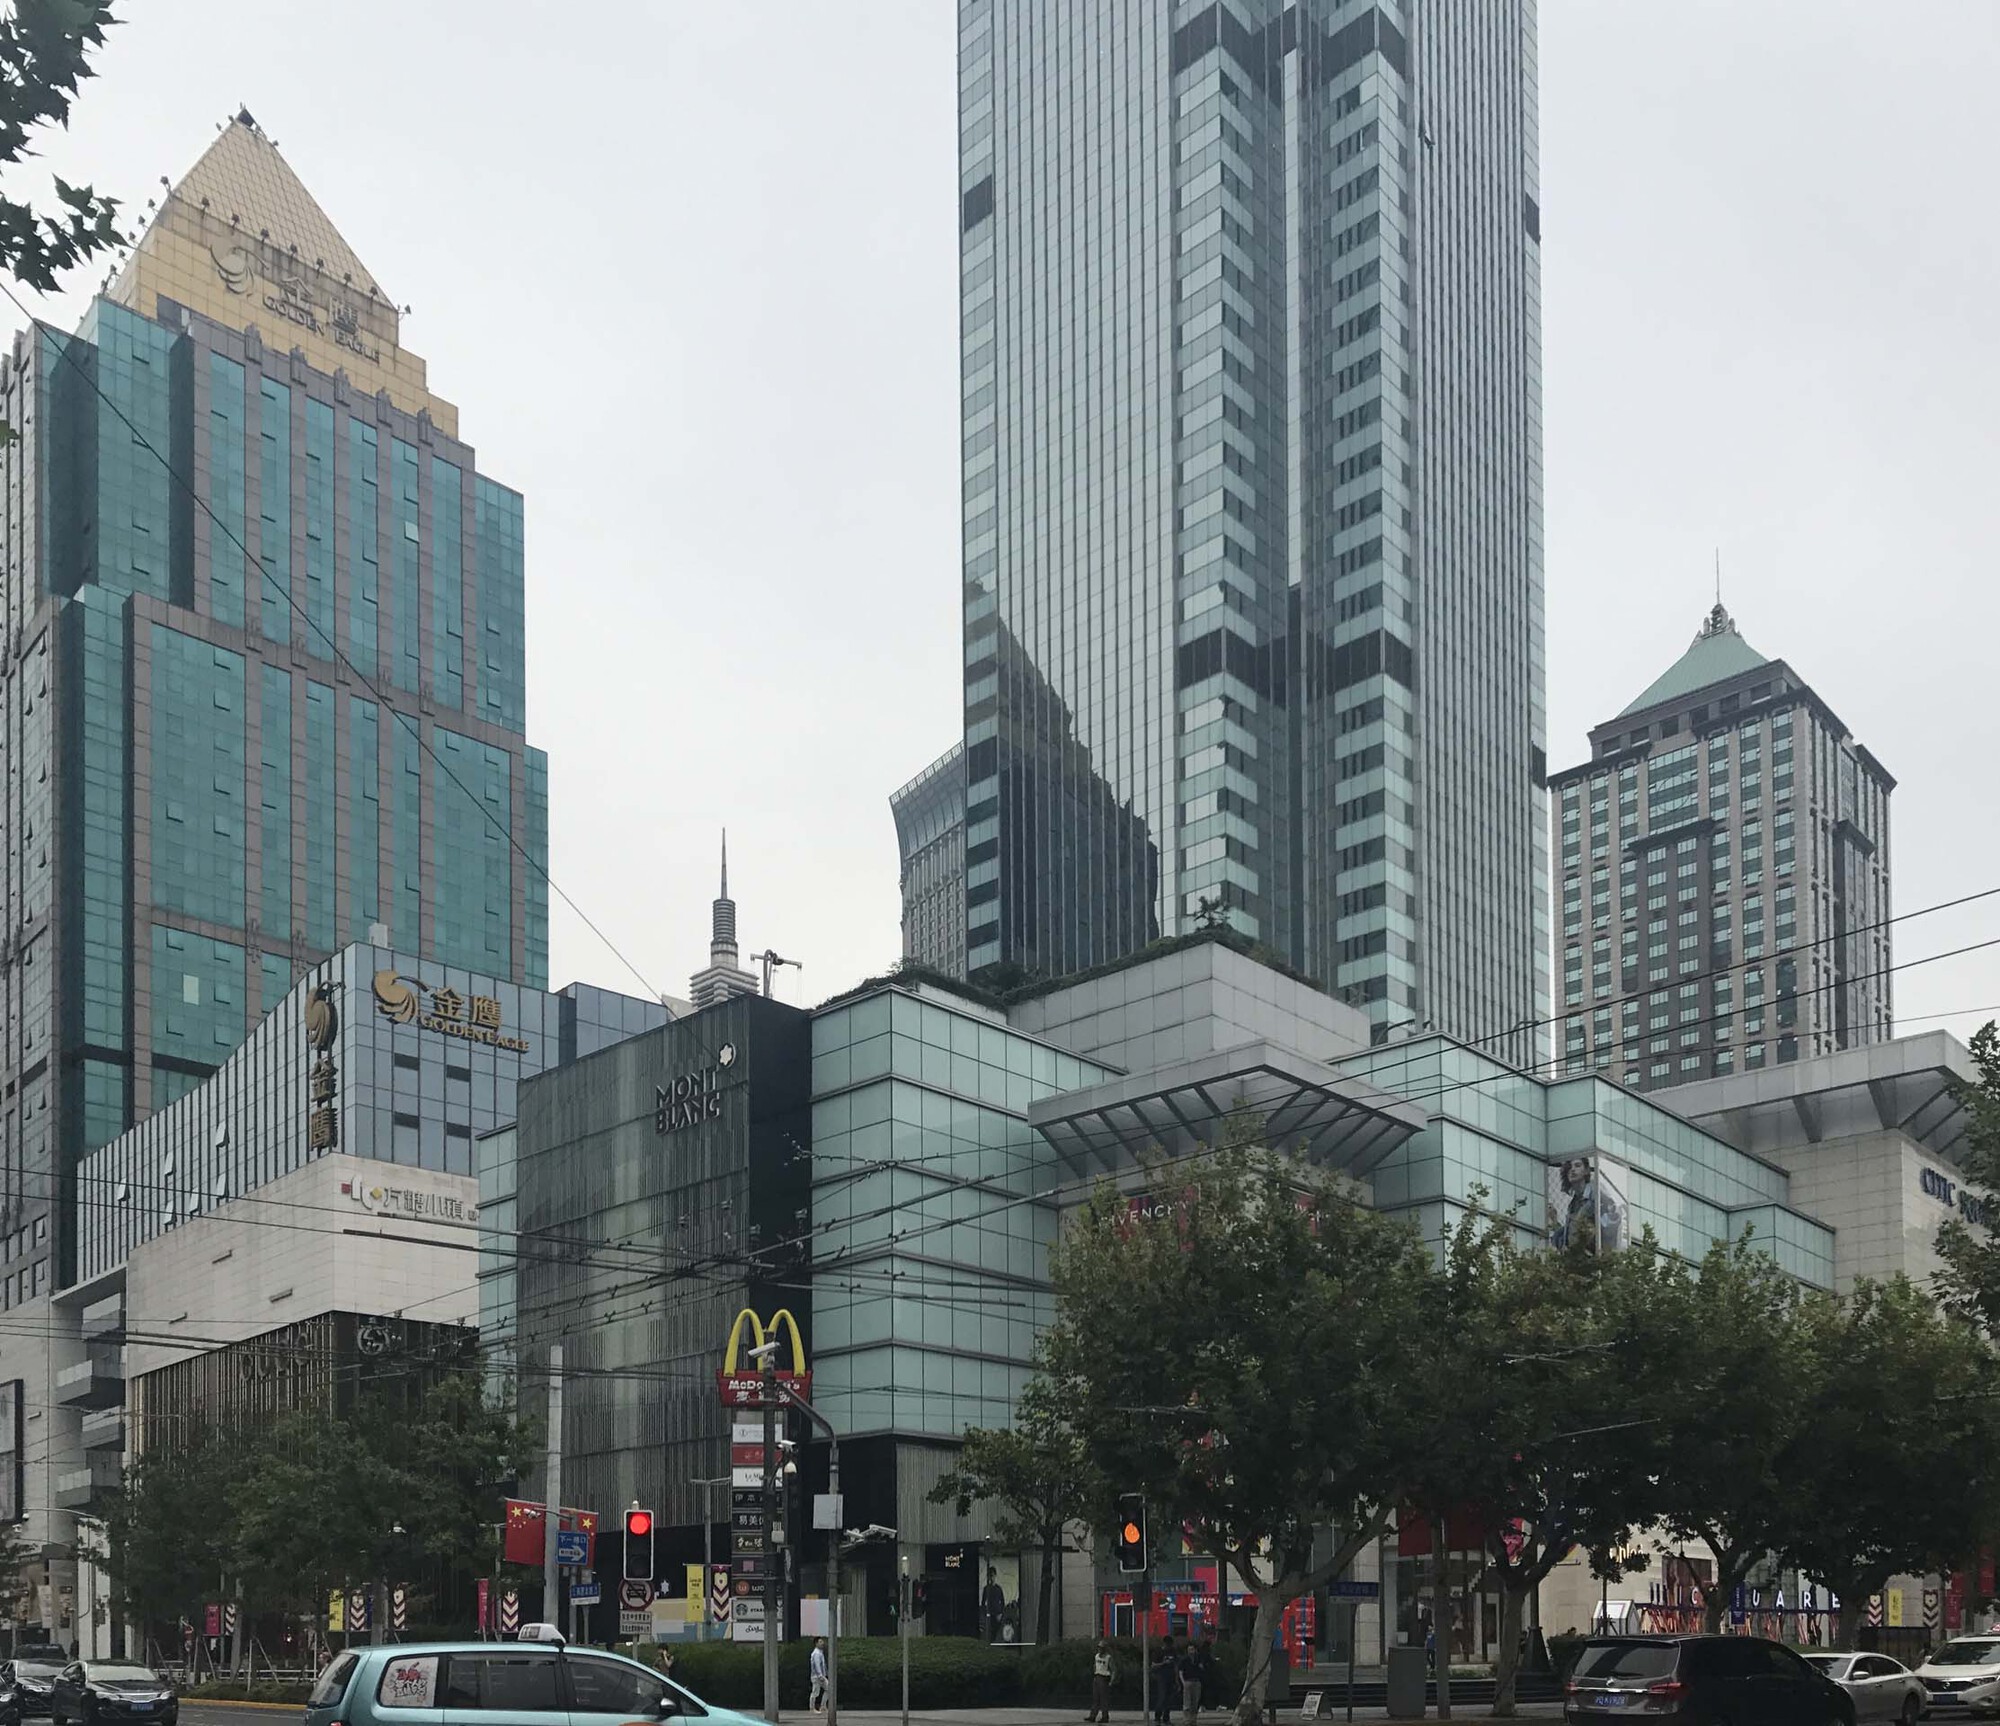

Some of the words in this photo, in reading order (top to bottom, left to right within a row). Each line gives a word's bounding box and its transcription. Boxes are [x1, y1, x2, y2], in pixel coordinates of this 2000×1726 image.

[263, 294, 325, 337] GOLDEN
[334, 328, 380, 367] EAGLE
[430, 987, 502, 1029] 金鹰
[418, 1013, 487, 1043] GOLDEN
[487, 1028, 530, 1054] EAGLE
[309, 1058, 338, 1151] 金鹰
[656, 1066, 720, 1107] MONT
[656, 1091, 720, 1135] BLANC
[384, 1186, 465, 1220] 方糖小镇
